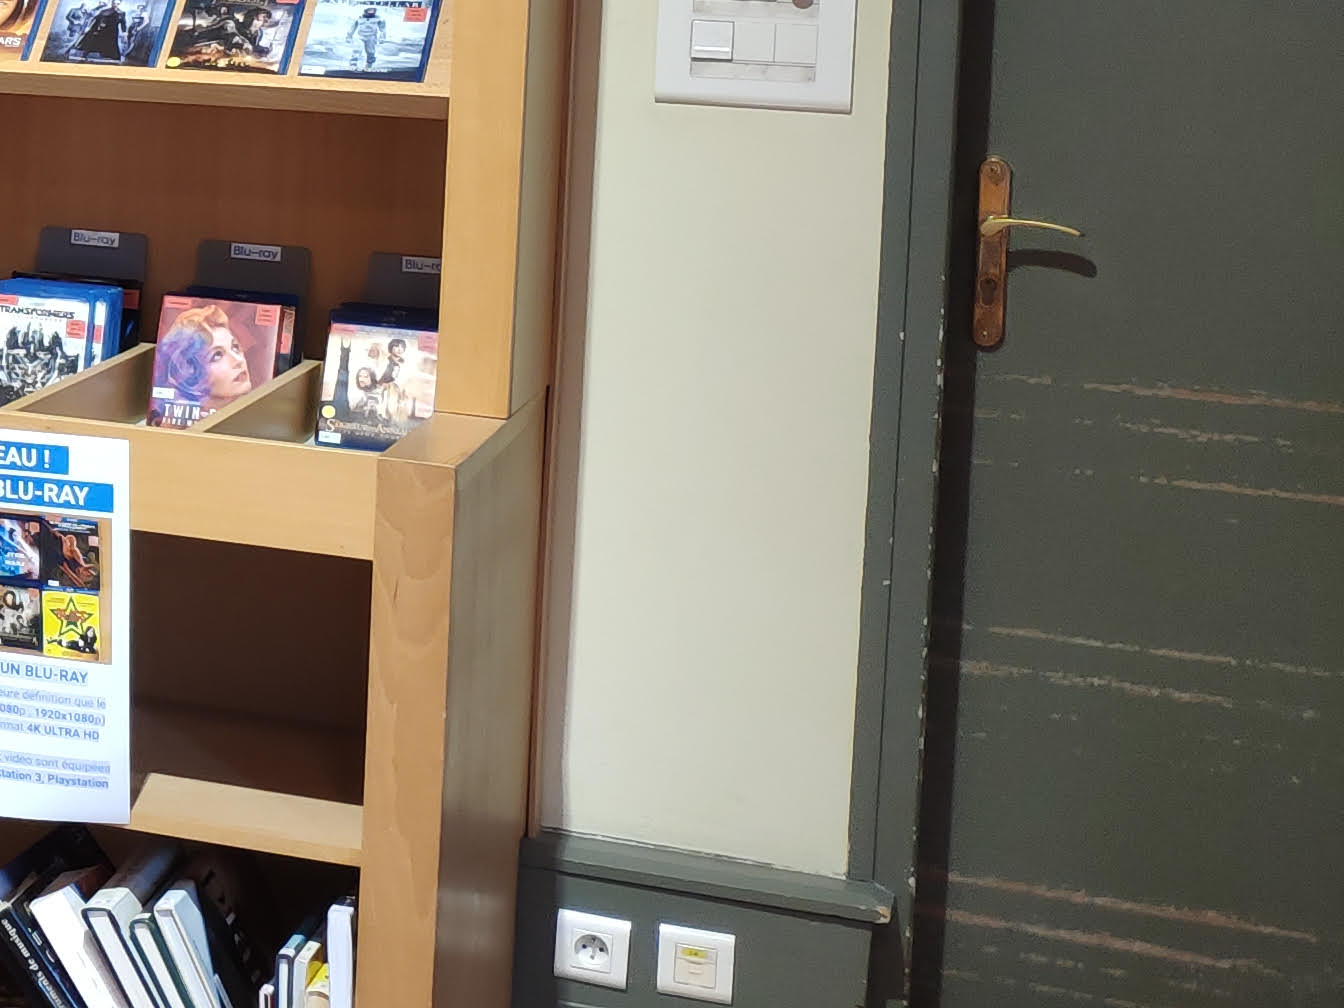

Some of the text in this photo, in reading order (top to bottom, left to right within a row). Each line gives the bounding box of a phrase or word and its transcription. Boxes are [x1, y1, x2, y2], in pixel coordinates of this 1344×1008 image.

[73, 231, 116, 245] Blu-ray
[233, 245, 279, 259] Blu-ray
[0, 305, 75, 319] TRANSFORMERS
[164, 403, 200, 419] TWIN
[43, 450, 51, 468] !
[1, 663, 21, 676] UN
[25, 665, 88, 684] BLU-RAY
[27, 723, 41, 733] 4K
[43, 725, 81, 739] ULTRA
[83, 730, 99, 741] HD
[48, 774, 109, 789] Playstation
[0, 918, 30, 958] musique
